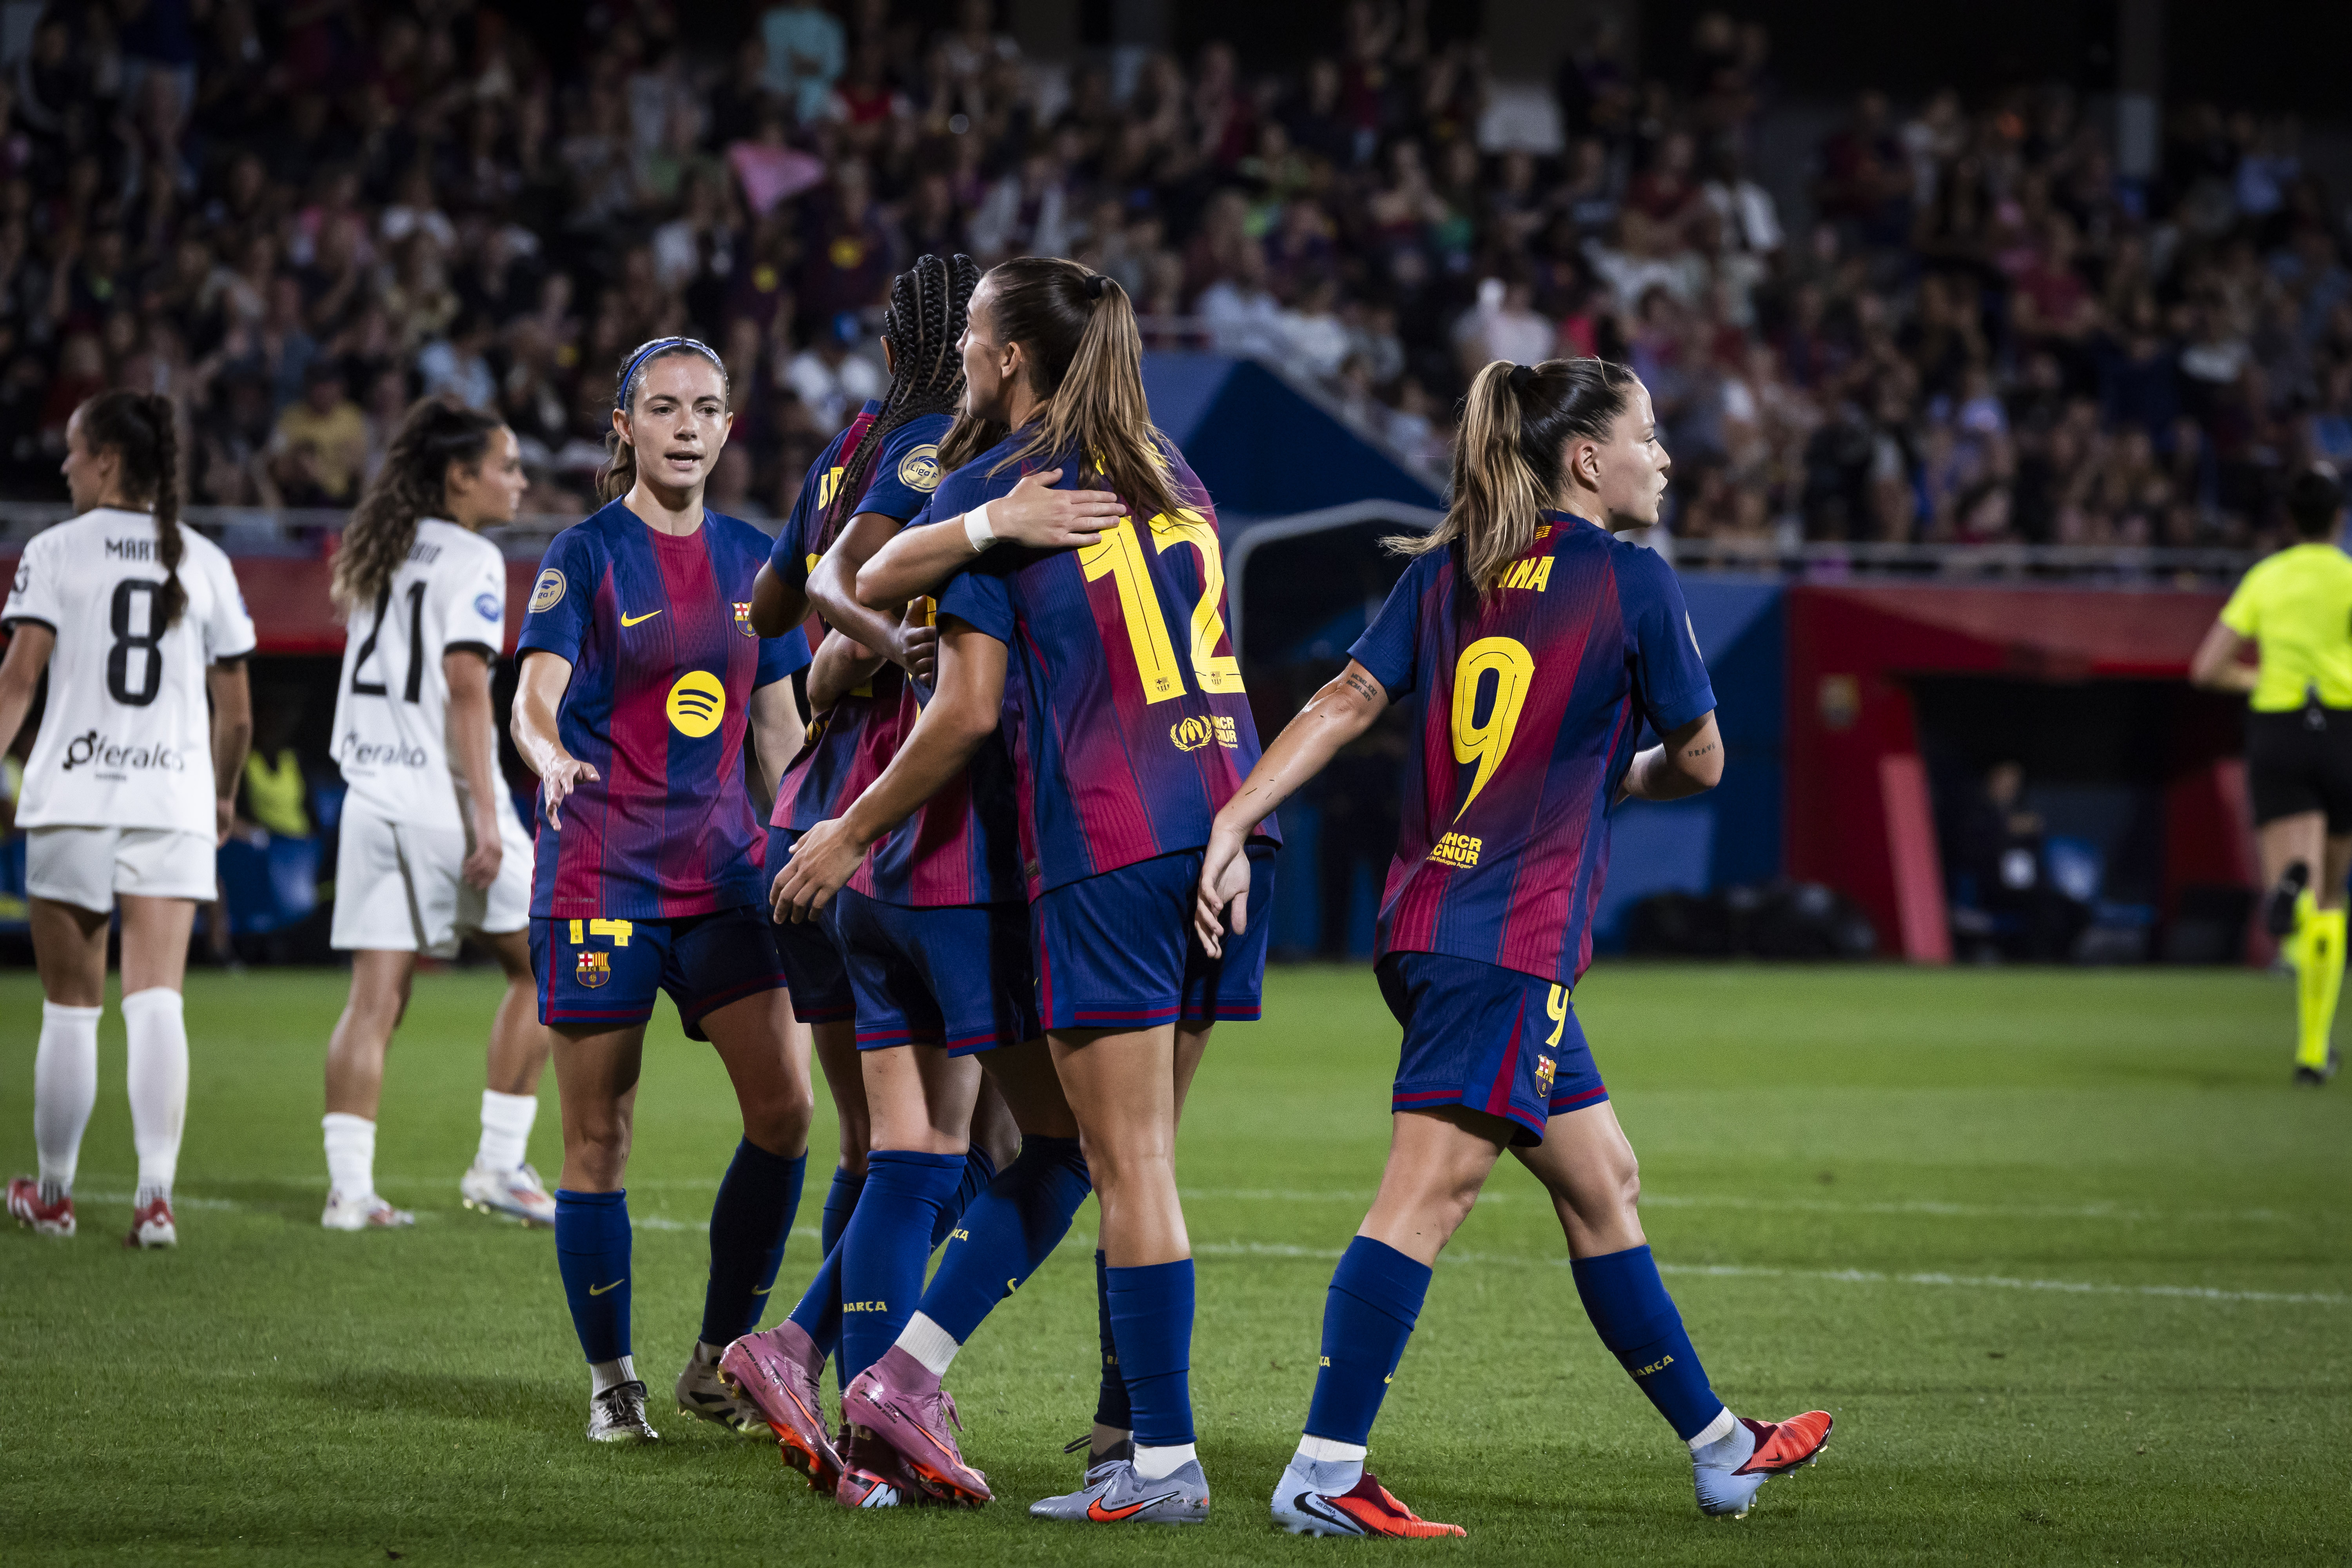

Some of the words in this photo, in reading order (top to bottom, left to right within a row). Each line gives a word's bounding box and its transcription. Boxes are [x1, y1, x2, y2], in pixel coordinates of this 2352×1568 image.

[910, 464, 931, 476] Liga
[1497, 556, 1555, 592] INA
[1077, 508, 1246, 705] 12
[106, 577, 168, 707] 8
[352, 576, 427, 704] 21
[1452, 637, 1535, 825] 9
[1430, 844, 1479, 865] CNUR
[1439, 832, 1482, 851] NHCR
[1436, 857, 1456, 865] Refugee
[1315, 1501, 1336, 1515] MEDINA
